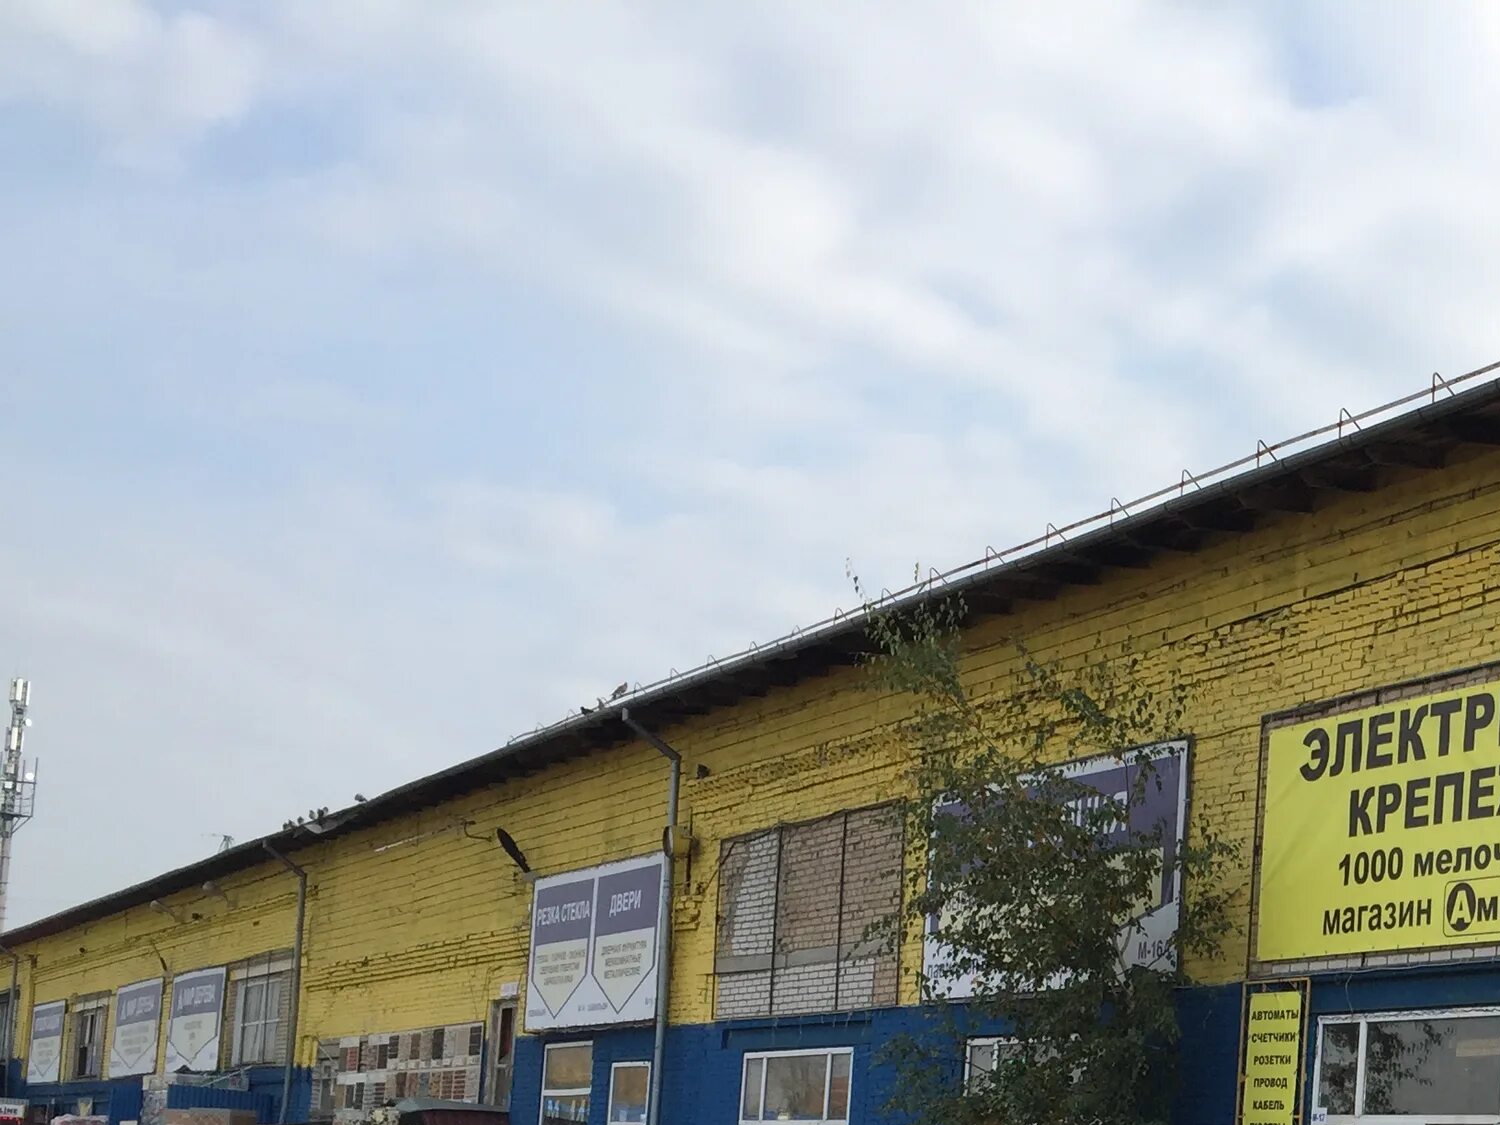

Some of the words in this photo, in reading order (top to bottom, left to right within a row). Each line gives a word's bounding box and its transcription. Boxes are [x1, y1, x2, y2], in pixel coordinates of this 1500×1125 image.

[1338, 847, 1402, 886] 1000
[608, 889, 642, 917] ДВЕРИ
[536, 905, 560, 927] РЕЗКА
[561, 900, 590, 922] СТЕКЛА
[1323, 898, 1432, 936] магазин
[1251, 1008, 1299, 1021] АВТОМАТЫ
[1251, 1030, 1296, 1043] СЧЕТЧИКИ
[1253, 1054, 1292, 1066] РОЗЕТКИ
[1253, 1077, 1288, 1089] ПРОВОД
[1252, 1099, 1285, 1111] КАБЕЛЬ
